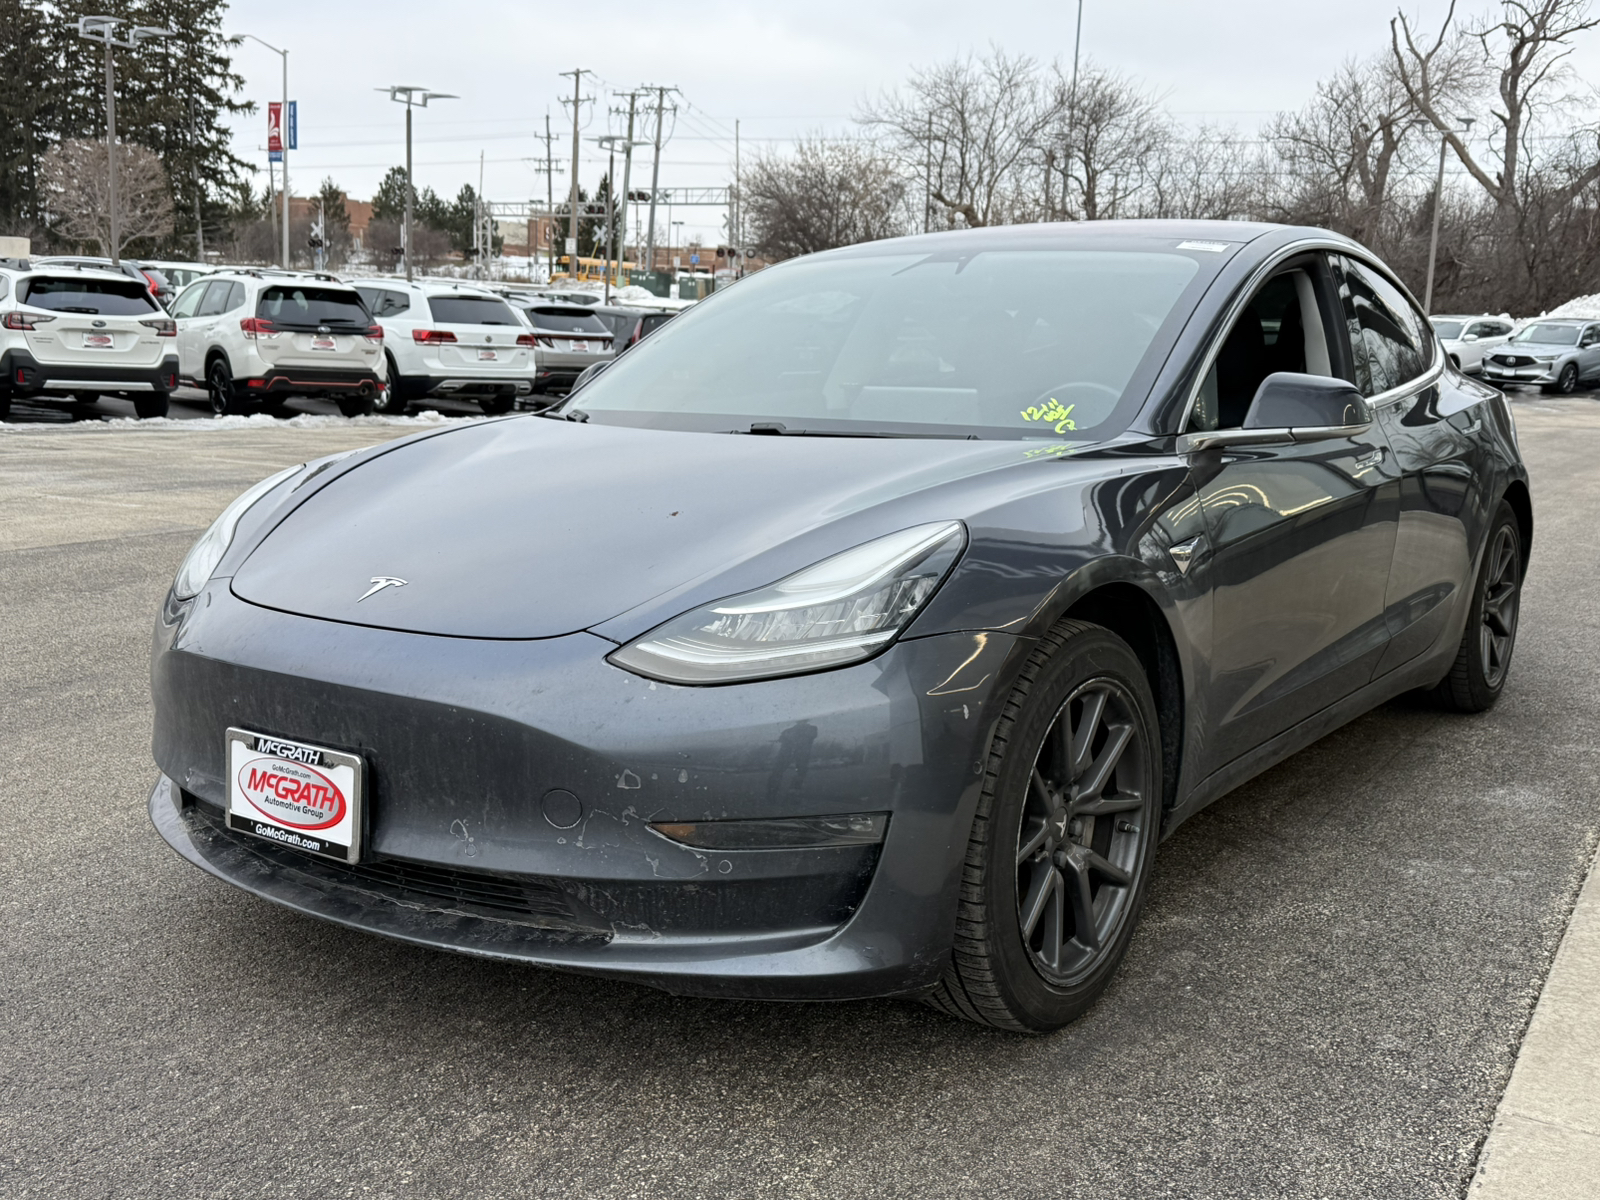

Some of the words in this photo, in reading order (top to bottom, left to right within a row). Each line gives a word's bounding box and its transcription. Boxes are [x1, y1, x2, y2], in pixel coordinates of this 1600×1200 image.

[272, 764, 311, 779] GoMcGrath.com
[264, 795, 301, 813] Automotive
[302, 805, 324, 820] Group
[255, 824, 320, 851] GoMcGrath.com
